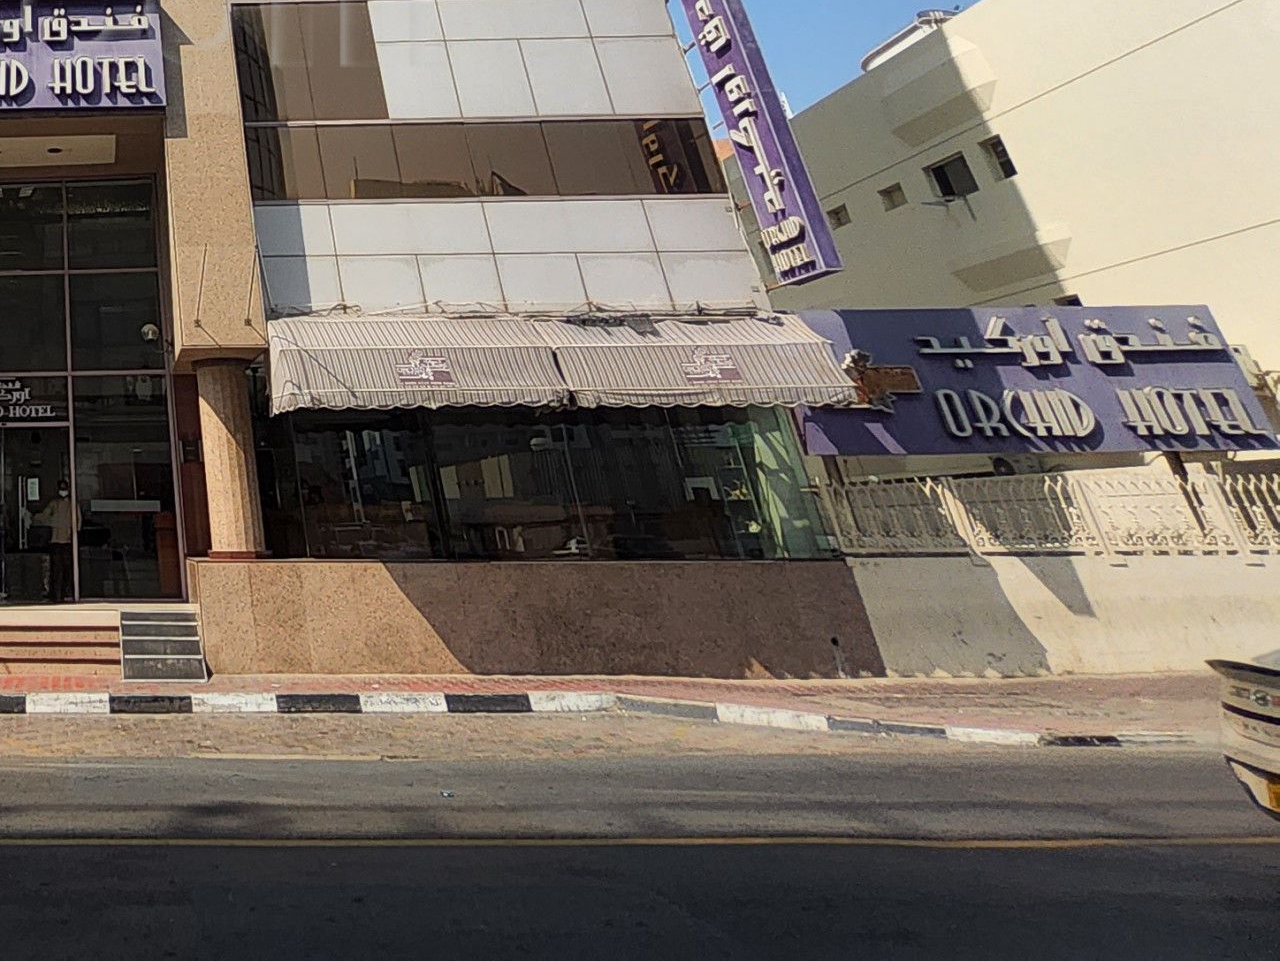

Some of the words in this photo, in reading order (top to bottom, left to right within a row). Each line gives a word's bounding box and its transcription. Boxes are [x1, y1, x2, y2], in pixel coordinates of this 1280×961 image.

[42, 4, 152, 42] فندق
[48, 54, 156, 95] HOTEL
[913, 315, 1074, 370] اوركيد
[1078, 315, 1223, 365] فندق
[8, 405, 56, 418] HOTEL
[935, 388, 1097, 438] ORCHID
[1114, 387, 1270, 437] HOTEL
